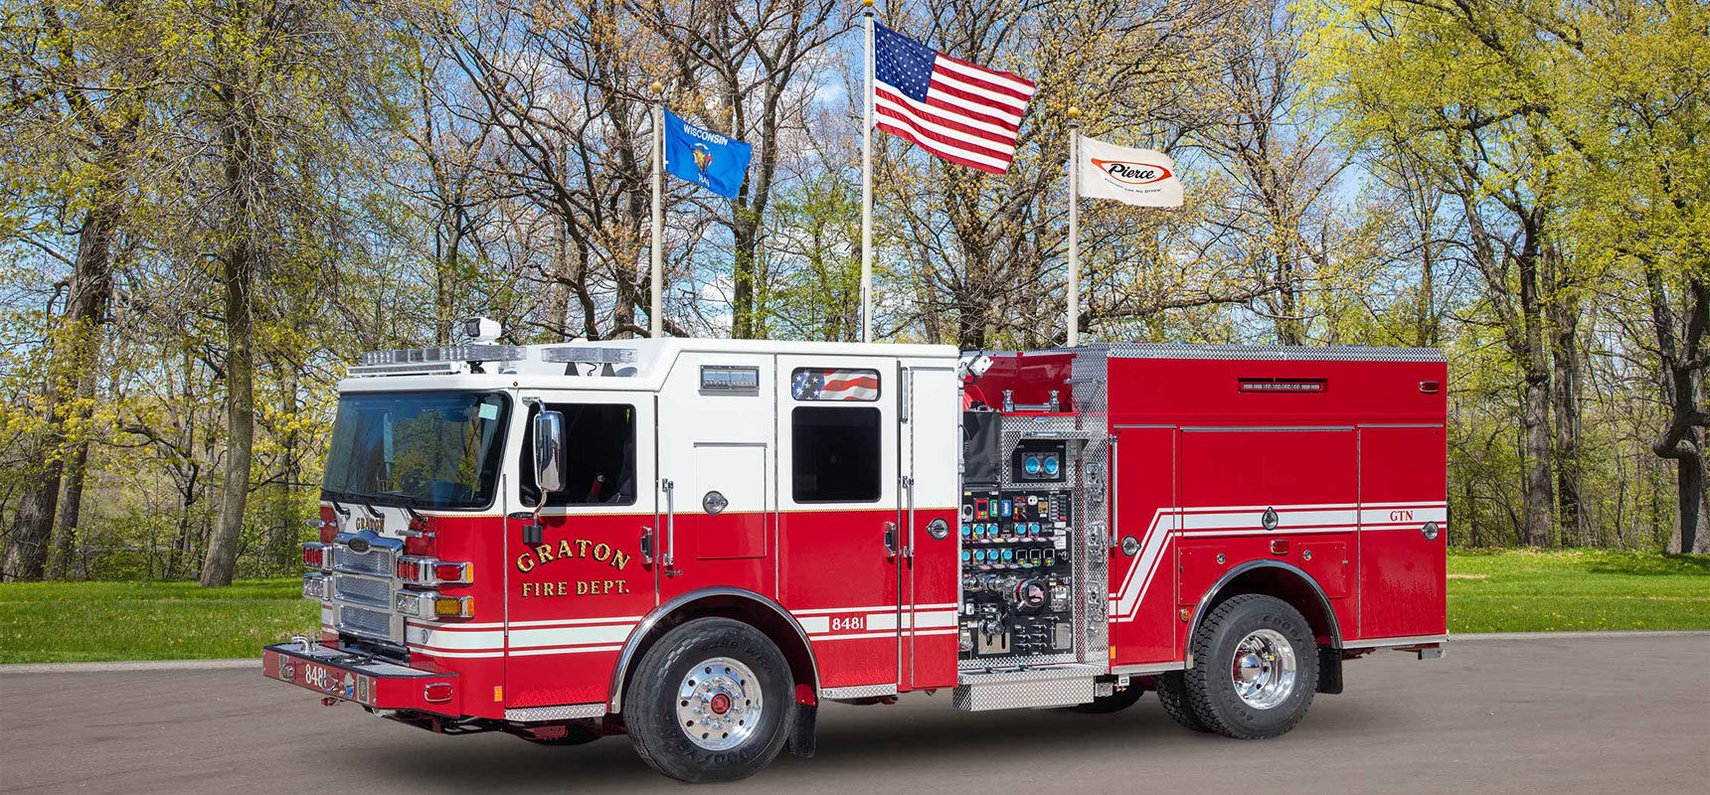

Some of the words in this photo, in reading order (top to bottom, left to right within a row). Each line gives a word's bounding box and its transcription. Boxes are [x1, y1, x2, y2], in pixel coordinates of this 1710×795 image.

[683, 123, 728, 146] WISCONSIN
[1109, 163, 1155, 180] Pierce
[1389, 510, 1413, 522] GTN
[516, 539, 631, 573] GRATON
[522, 582, 568, 597] FIRE
[576, 579, 630, 596] DEPT.
[832, 616, 864, 631] 8481
